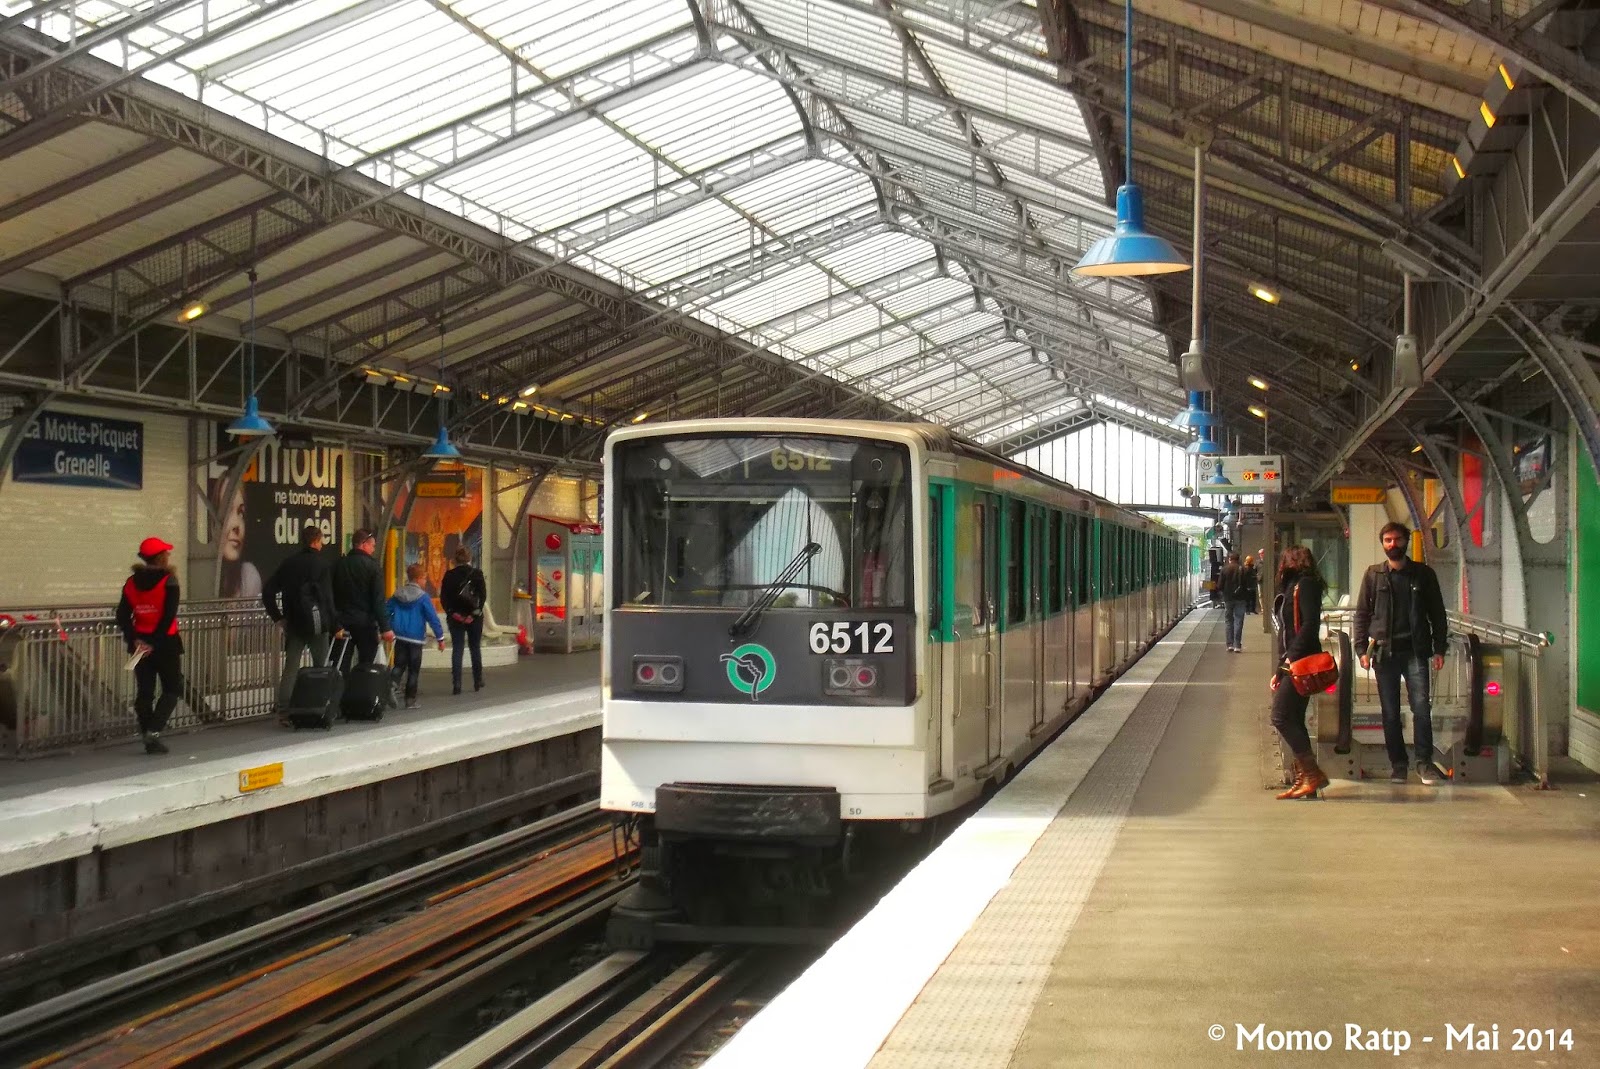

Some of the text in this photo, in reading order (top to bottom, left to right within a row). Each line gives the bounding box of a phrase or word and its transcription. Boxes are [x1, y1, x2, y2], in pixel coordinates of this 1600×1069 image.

[45, 418, 138, 452] Motte-Picquet
[55, 450, 111, 477] Grenelle
[771, 450, 831, 471] 6512
[275, 490, 336, 509] ne tombe pas
[275, 508, 299, 545] du
[809, 622, 894, 654] 6512
